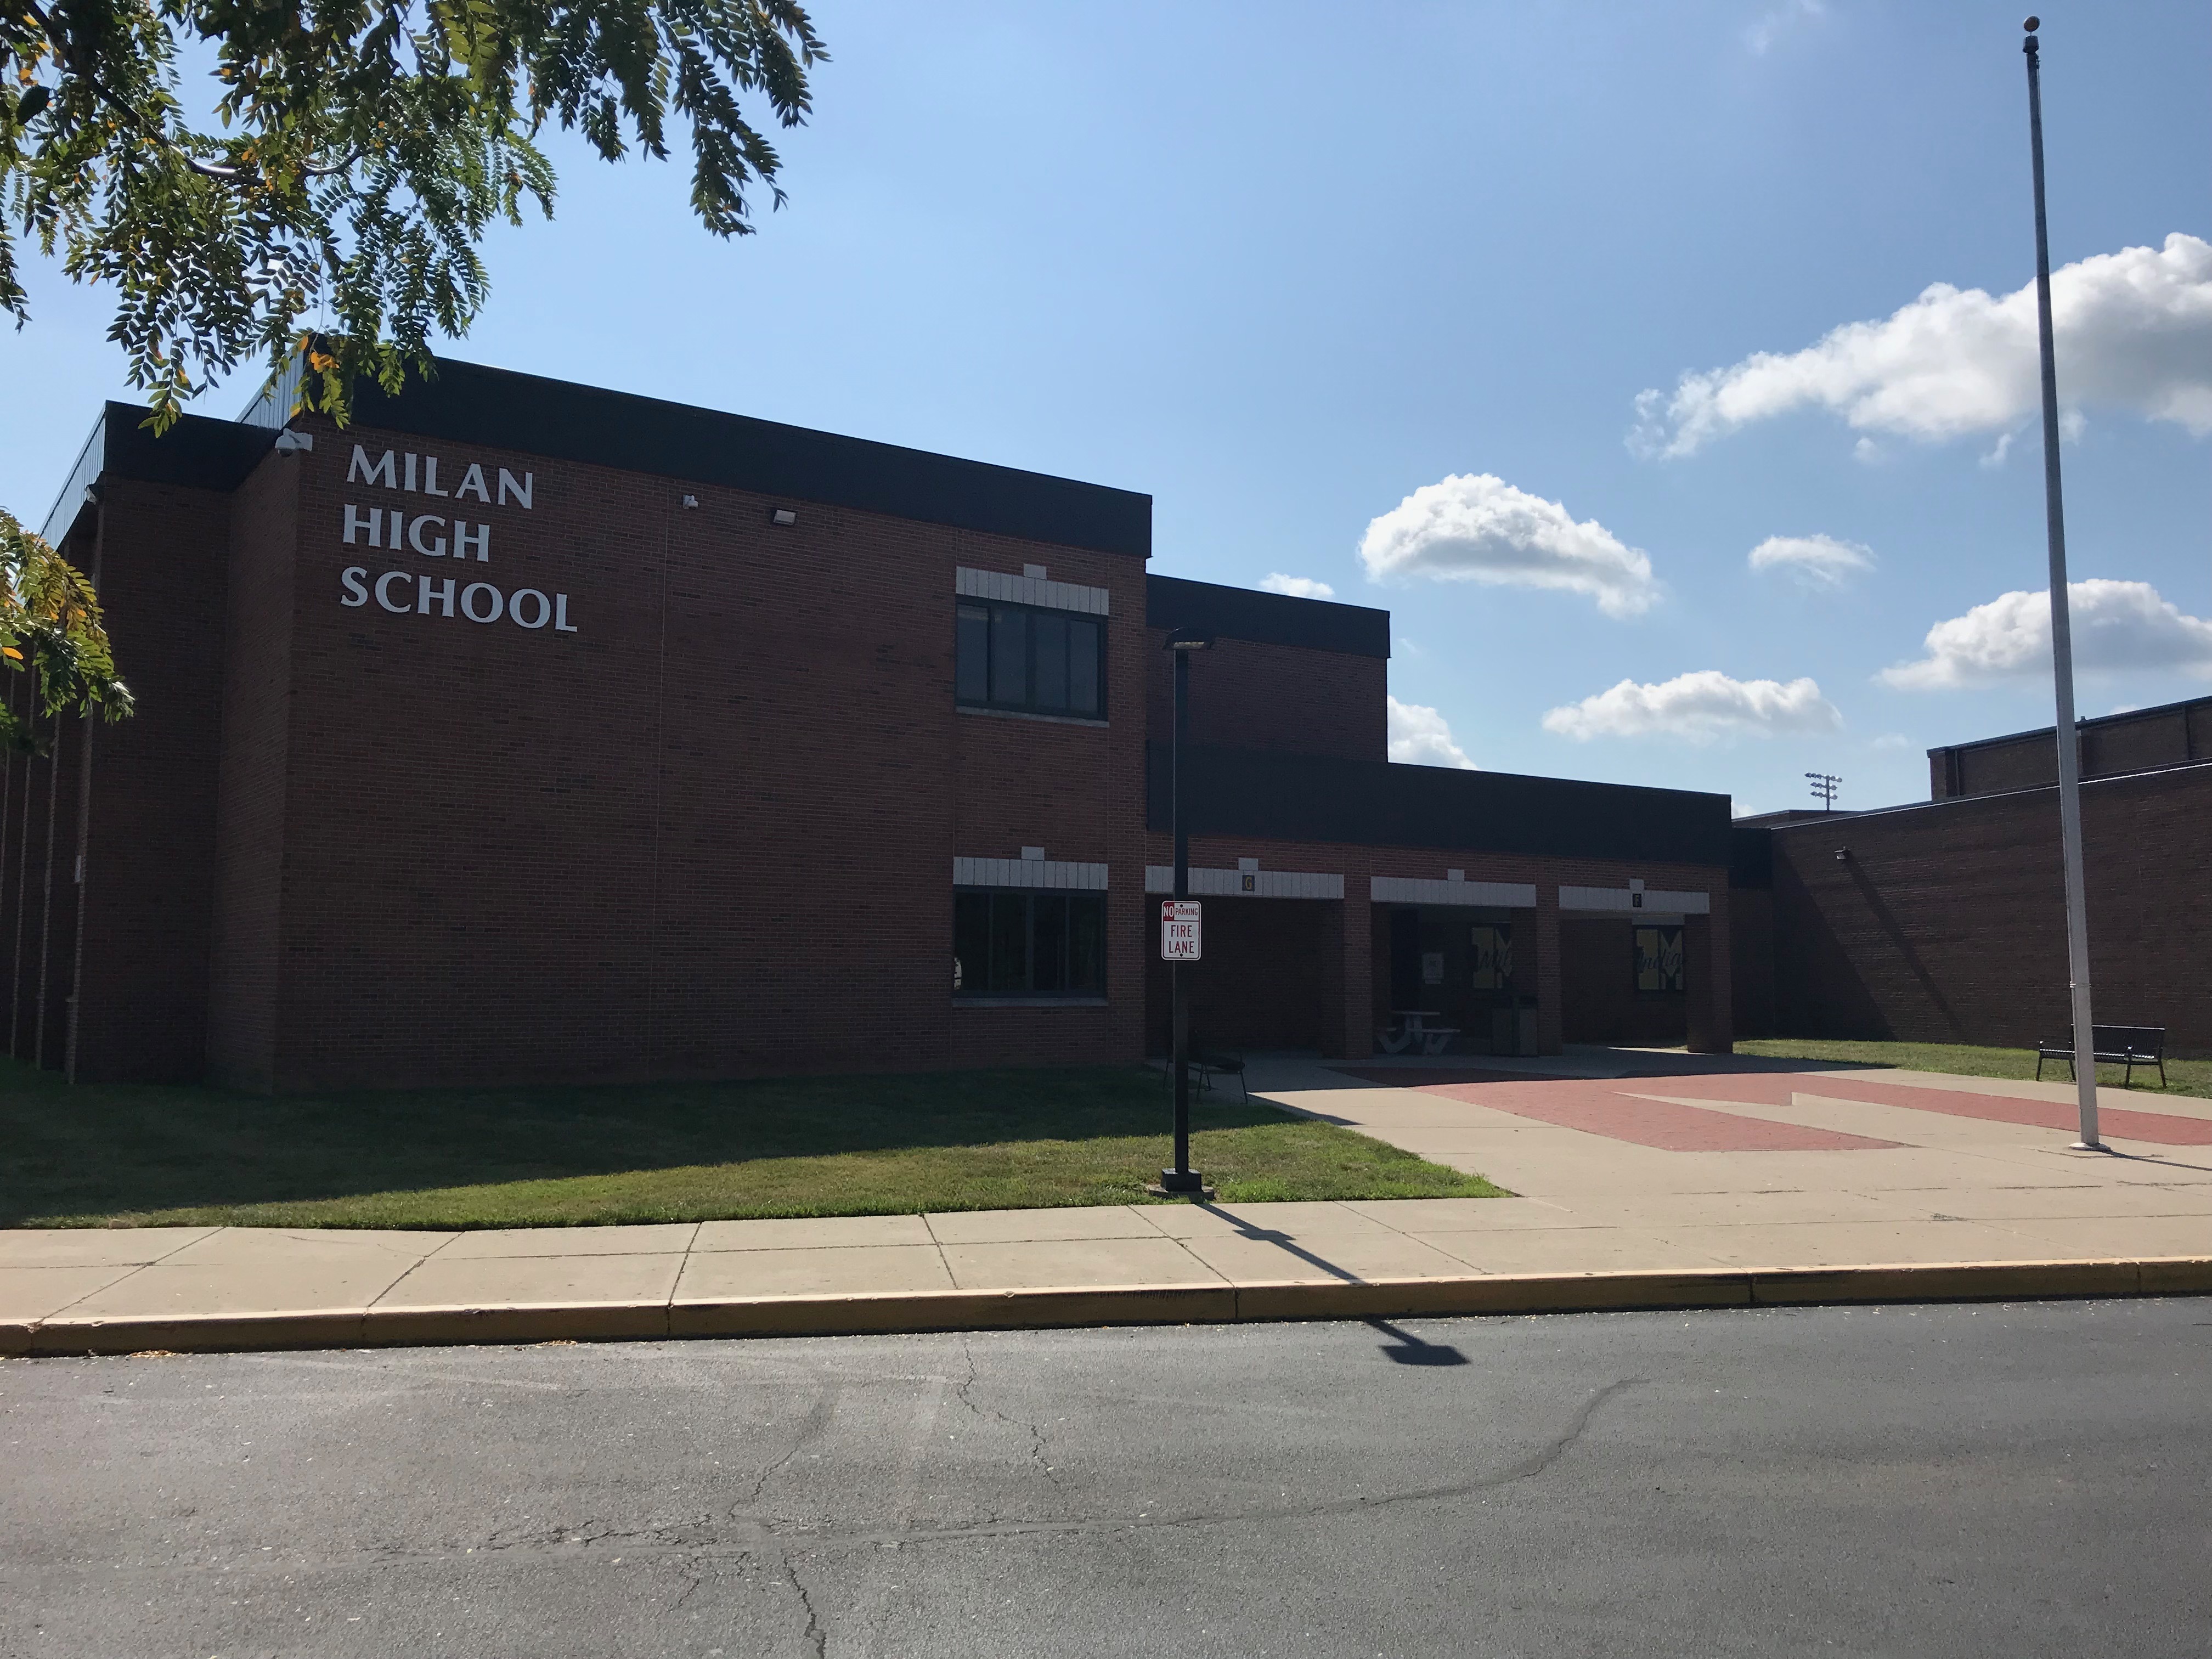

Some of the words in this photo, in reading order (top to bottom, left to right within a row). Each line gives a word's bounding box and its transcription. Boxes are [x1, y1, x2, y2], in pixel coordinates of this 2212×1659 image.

[346, 444, 533, 510] MILAN
[343, 504, 490, 562] HIGH
[340, 566, 578, 632] SCHOOL
[1245, 876, 1252, 890] G
[1163, 906, 1174, 917] NO
[1171, 925, 1192, 937] FIRE
[1169, 941, 1194, 953] LANE
